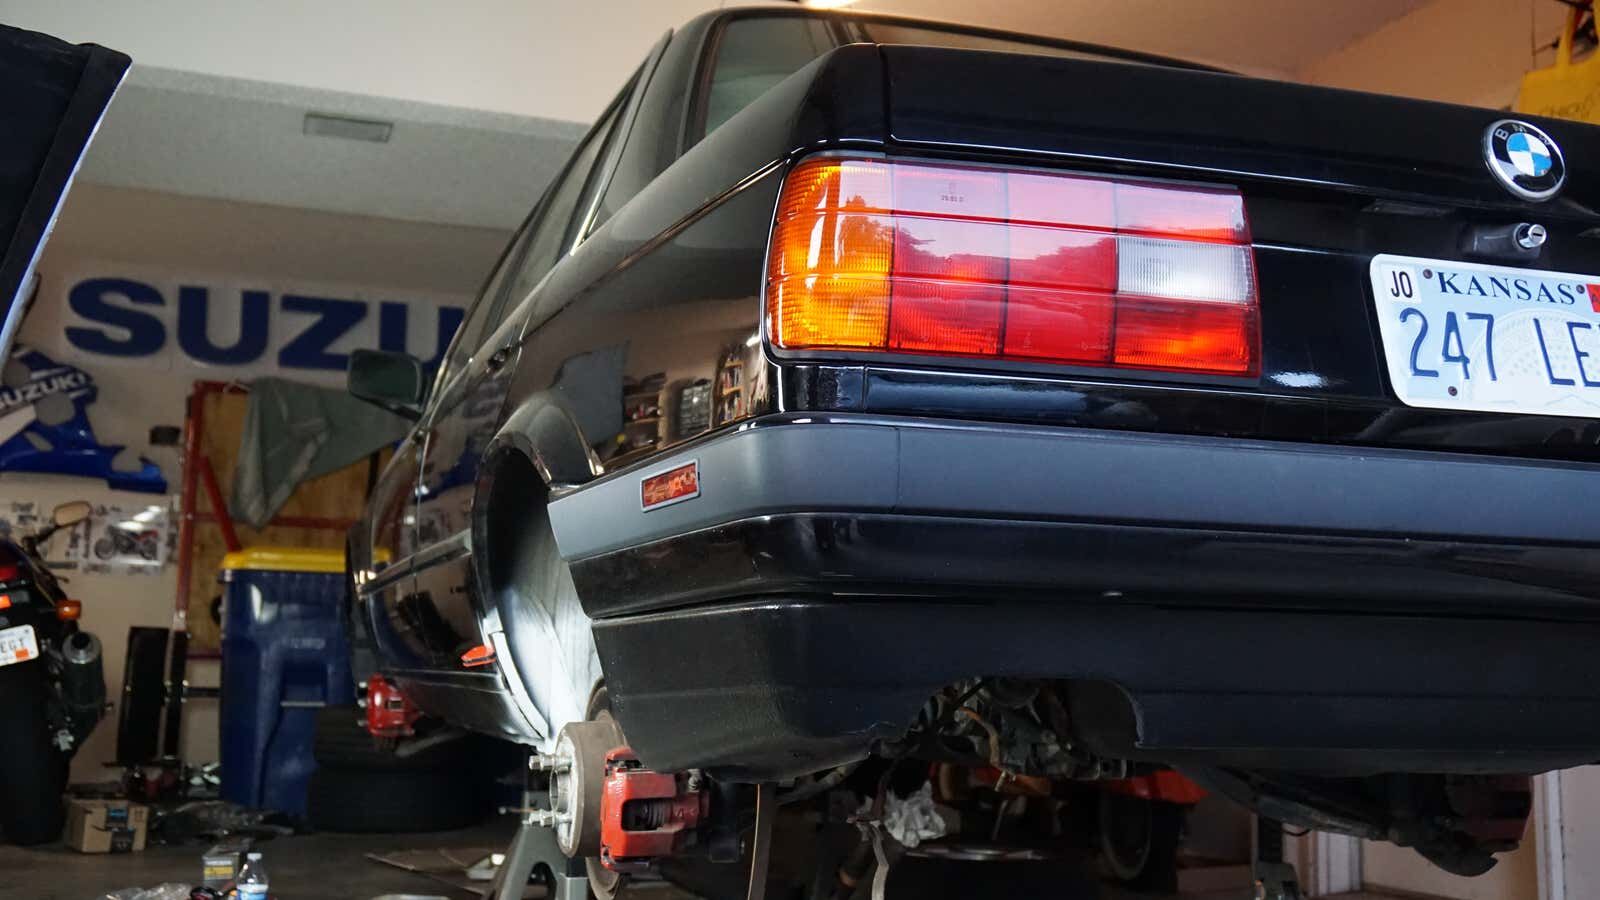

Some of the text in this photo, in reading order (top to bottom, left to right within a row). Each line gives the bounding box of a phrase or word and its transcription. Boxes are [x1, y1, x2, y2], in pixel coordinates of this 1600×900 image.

[1494, 123, 1551, 146] BMW
[1436, 271, 1576, 306] KANSAS
[1399, 307, 1600, 388] 247 LE
[0, 372, 87, 409] UZUKI
